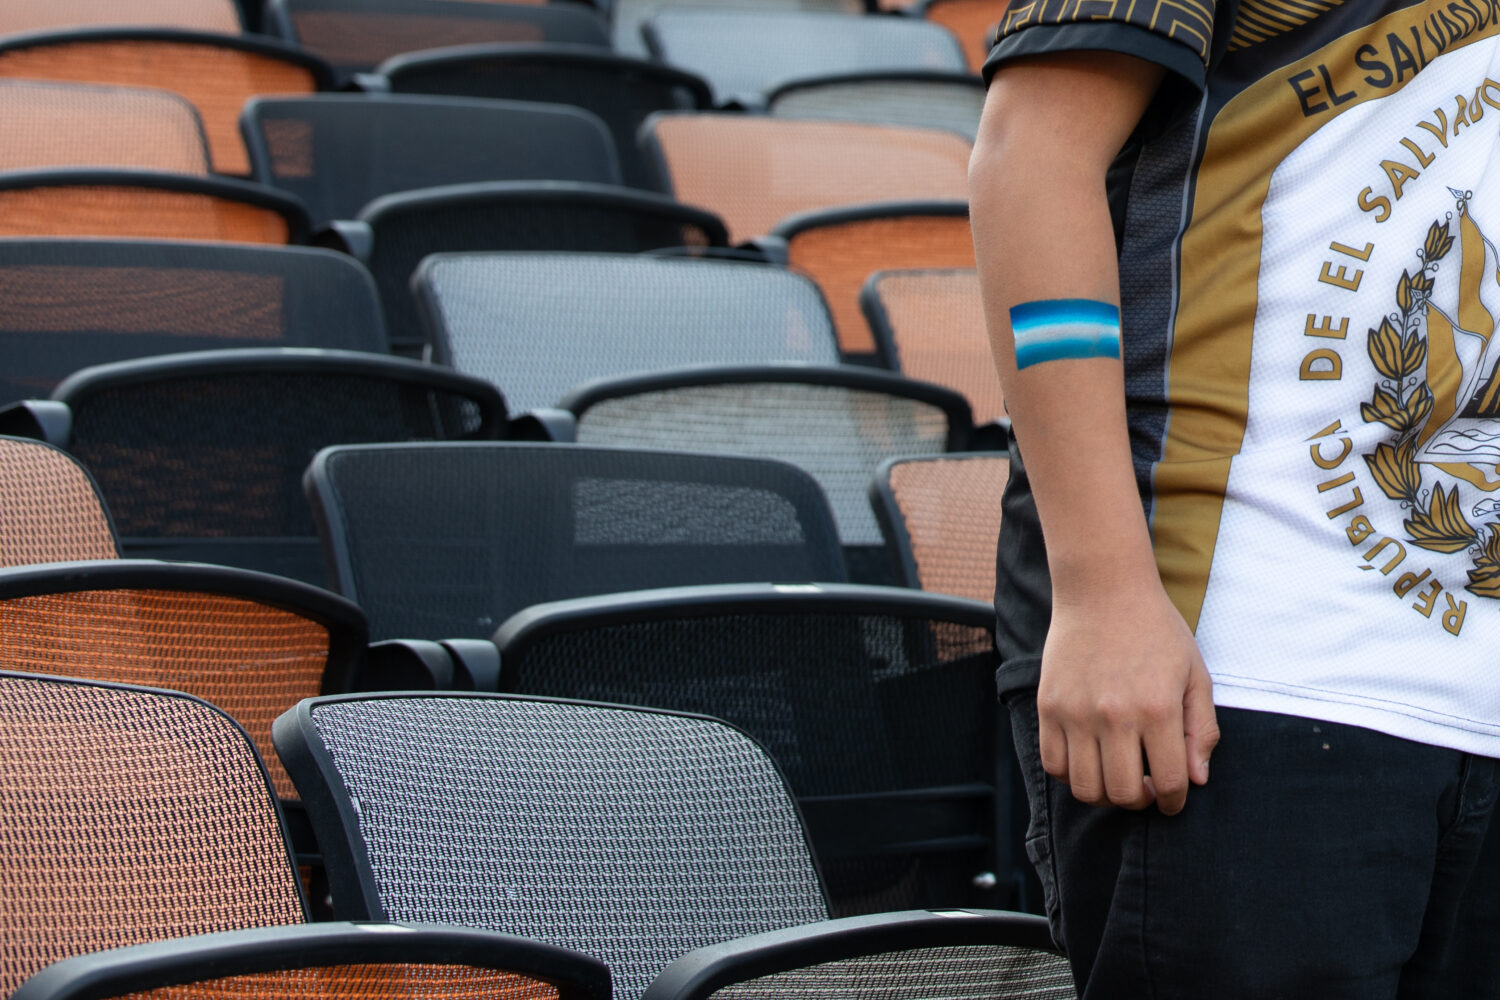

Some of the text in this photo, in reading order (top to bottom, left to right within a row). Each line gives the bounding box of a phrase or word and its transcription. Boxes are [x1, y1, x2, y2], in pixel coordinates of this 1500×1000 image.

[1288, 64, 1357, 117] EL
[1318, 241, 1374, 292] EL
[1299, 313, 1350, 381] DE
